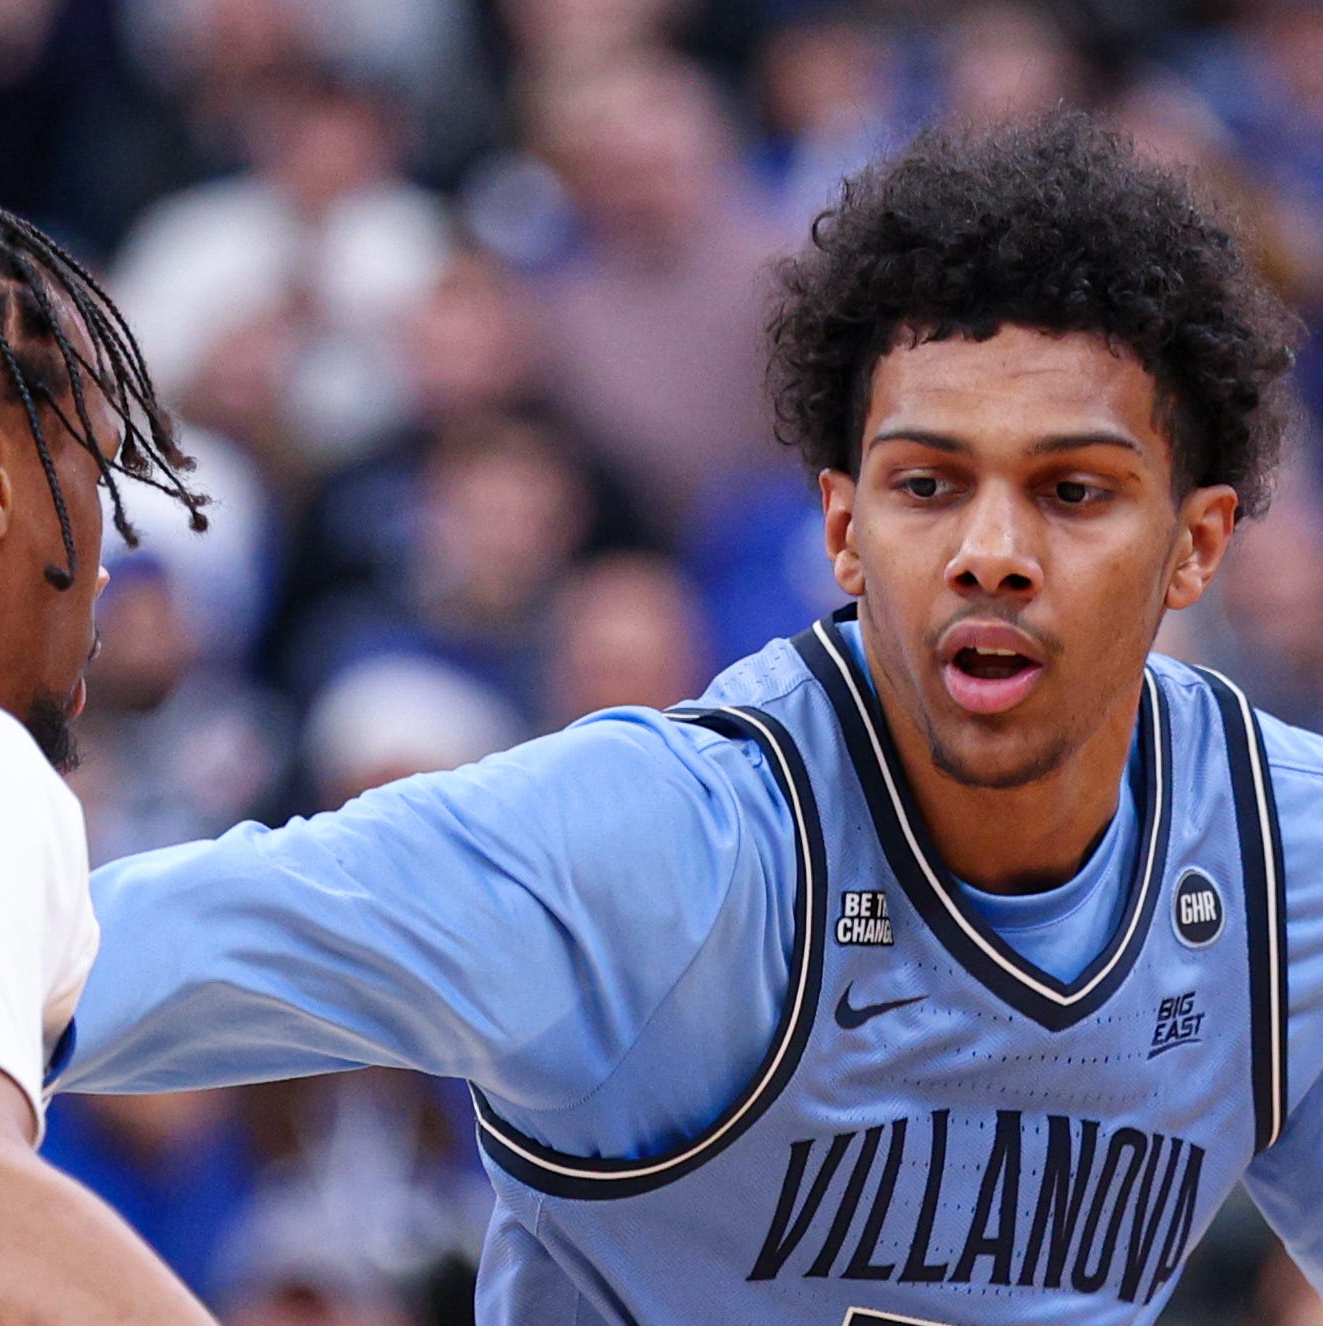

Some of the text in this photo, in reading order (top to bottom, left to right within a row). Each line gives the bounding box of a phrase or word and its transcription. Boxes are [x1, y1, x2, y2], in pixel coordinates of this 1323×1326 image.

[844, 892, 873, 917] BE
[1180, 890, 1217, 925] GHR
[837, 917, 893, 944] CHANG
[1157, 991, 1197, 1022] BIG
[1151, 1012, 1206, 1046] EAST
[745, 1109, 1205, 1305] VILLANOVA
